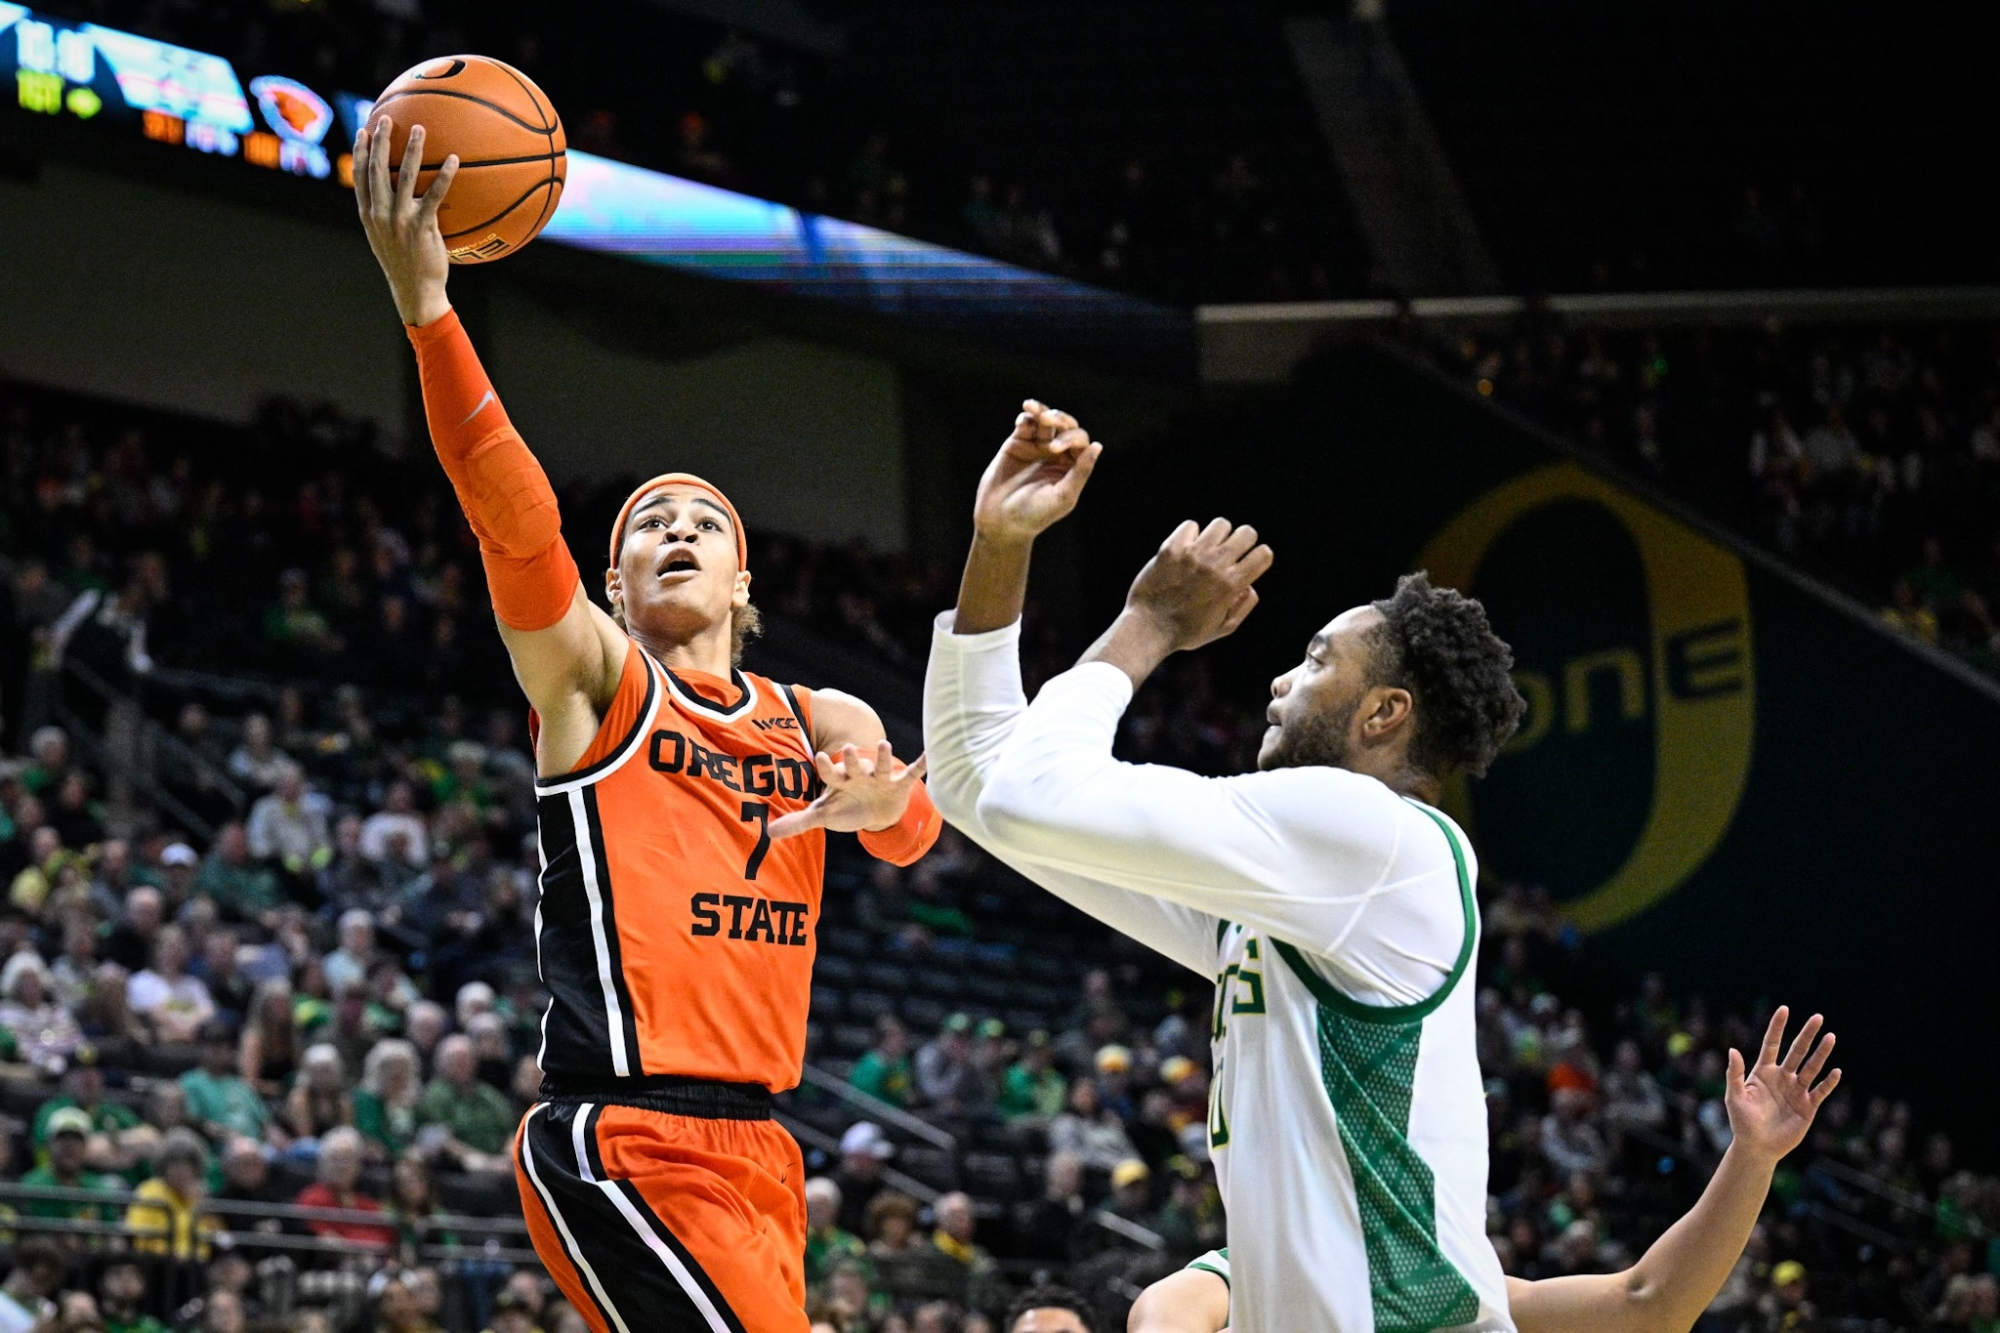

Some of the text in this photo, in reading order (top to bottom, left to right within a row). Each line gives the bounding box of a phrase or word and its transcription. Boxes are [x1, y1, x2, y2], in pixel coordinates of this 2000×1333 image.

[752, 717, 799, 731] WCC
[741, 801, 771, 880] 7
[691, 892, 809, 946] STATE
